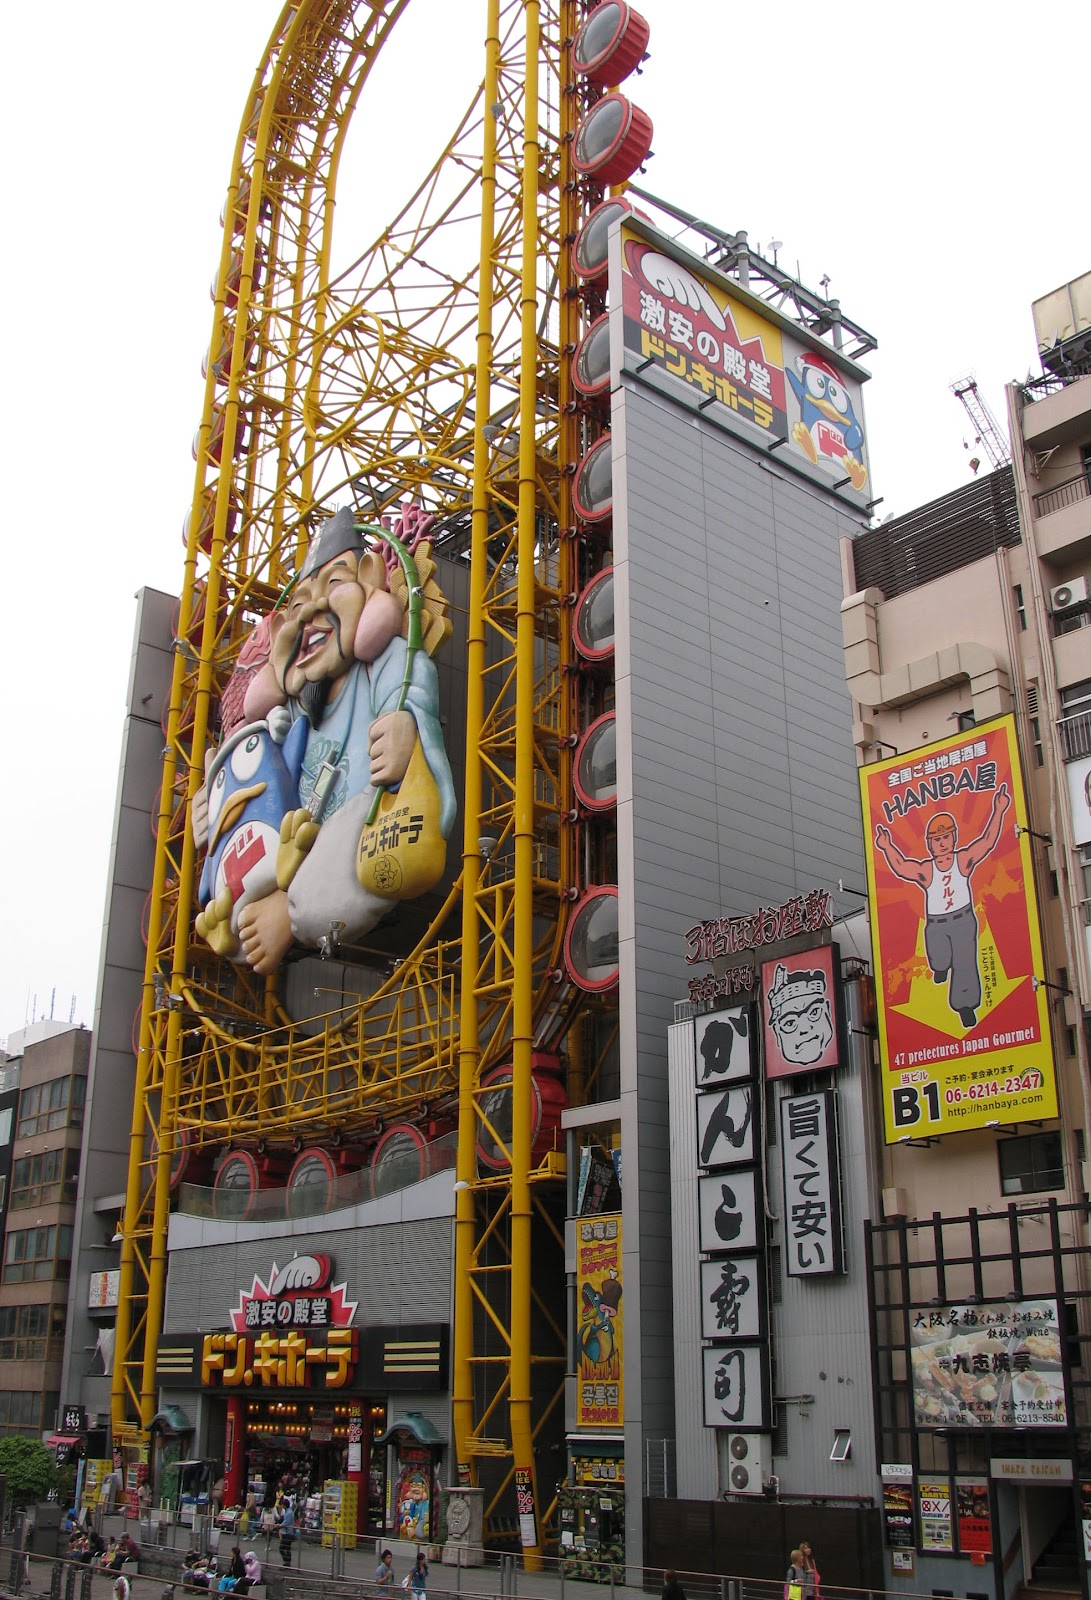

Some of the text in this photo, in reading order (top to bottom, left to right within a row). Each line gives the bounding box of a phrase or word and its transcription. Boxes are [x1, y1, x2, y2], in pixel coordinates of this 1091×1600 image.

[639, 290, 773, 401] 激安の殿堂
[887, 740, 988, 788] 全国ご当地居酒屋
[882, 761, 997, 823] HANBA屋
[941, 871, 955, 911] グルメ
[684, 888, 834, 966] 3階はお座敷
[894, 1025, 1035, 1066] 47 prefectures Japan Gourmet
[901, 1069, 929, 1085] 当ビル
[945, 1064, 1015, 1085] ご予約・宴会承ります
[945, 1073, 1041, 1103] 06-6214-2347
[892, 1082, 941, 1127] B1
[947, 1093, 1043, 1117] http://hanbaya.com
[787, 1098, 828, 1268] 旨くて安い
[245, 1297, 328, 1326] 激安の殿堂
[913, 1309, 979, 1329] 大阪名物
[582, 1383, 619, 1407] 공룡집
[1001, 1413, 1065, 1424] 06-6213-8540
